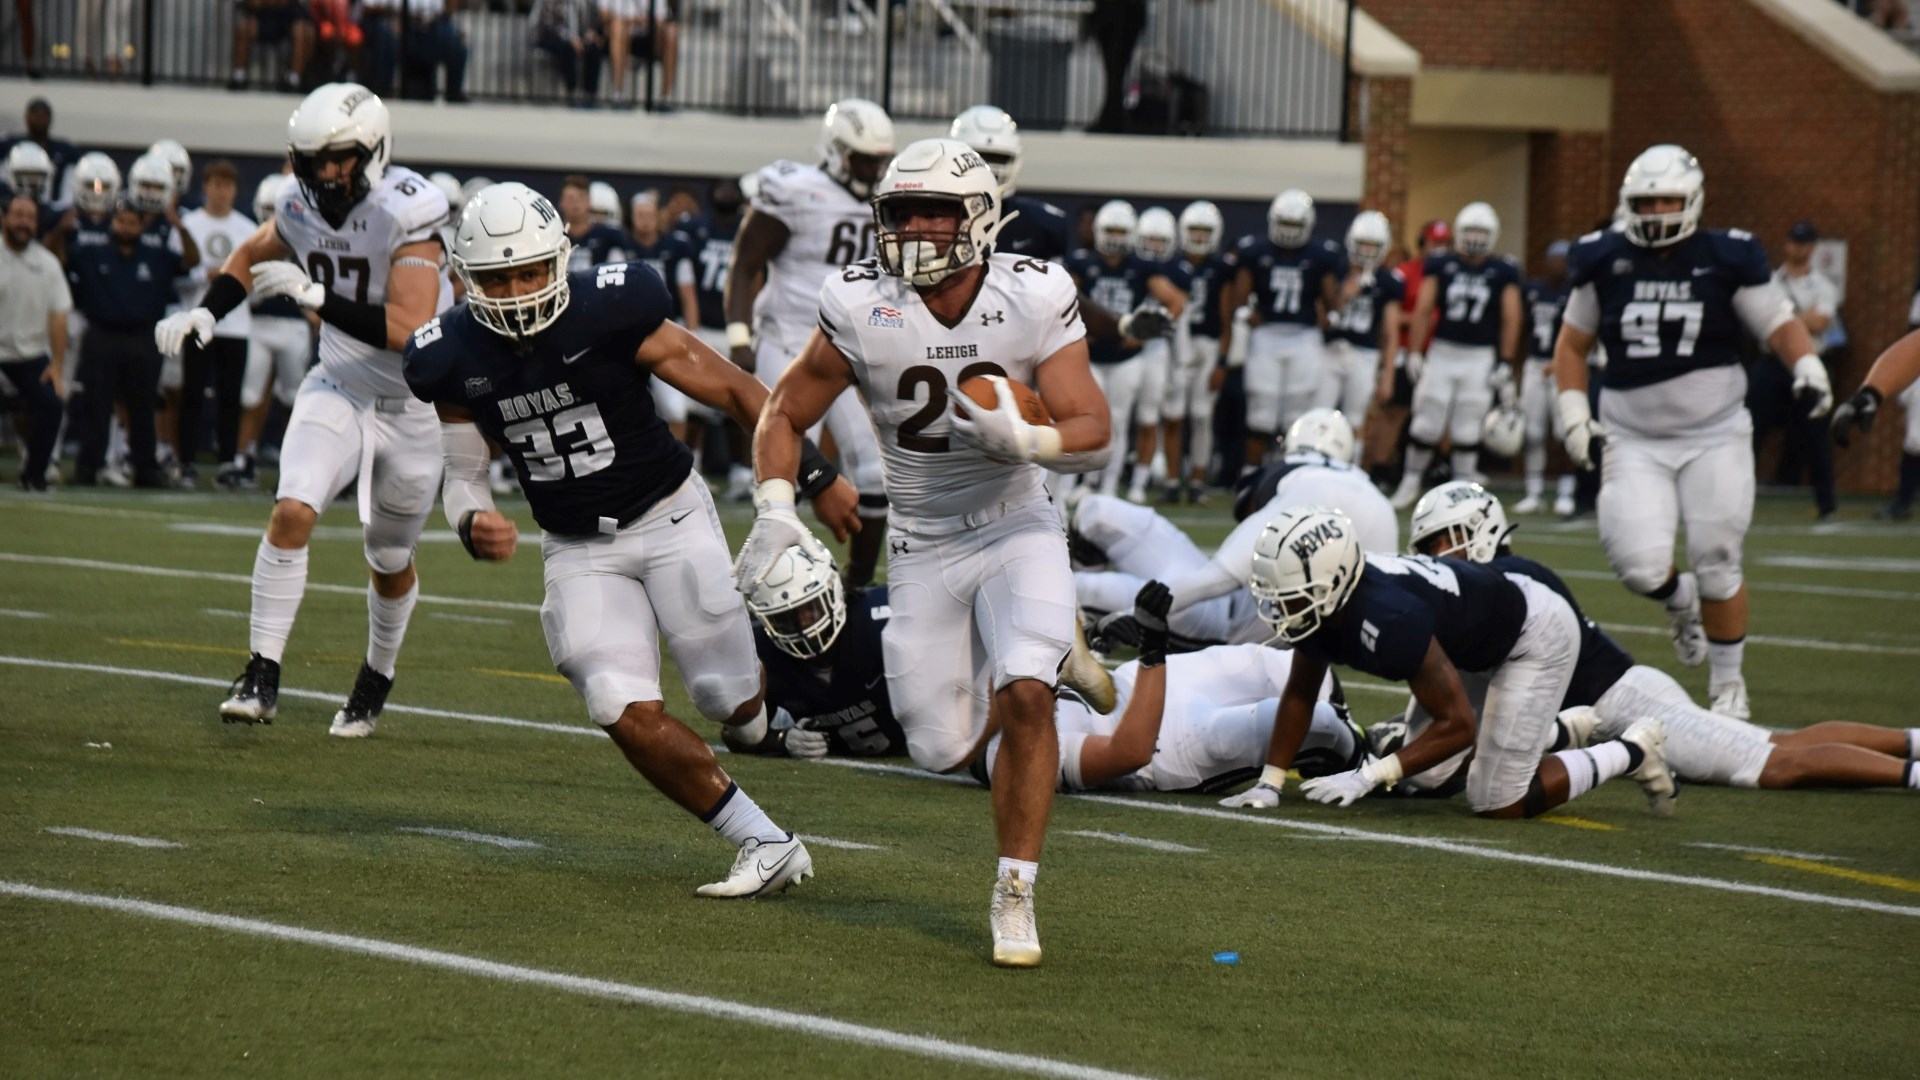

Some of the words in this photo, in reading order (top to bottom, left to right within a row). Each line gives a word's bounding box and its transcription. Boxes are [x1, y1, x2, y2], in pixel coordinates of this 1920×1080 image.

[597, 263, 628, 289] 33
[1634, 280, 1693, 301] HOYAS
[1620, 301, 1705, 359] 97
[926, 344, 978, 360] LEHIGH
[497, 382, 575, 422] HOYAS
[503, 401, 616, 482] 33
[1289, 518, 1344, 559] HOYAS
[838, 716, 890, 756] 5
